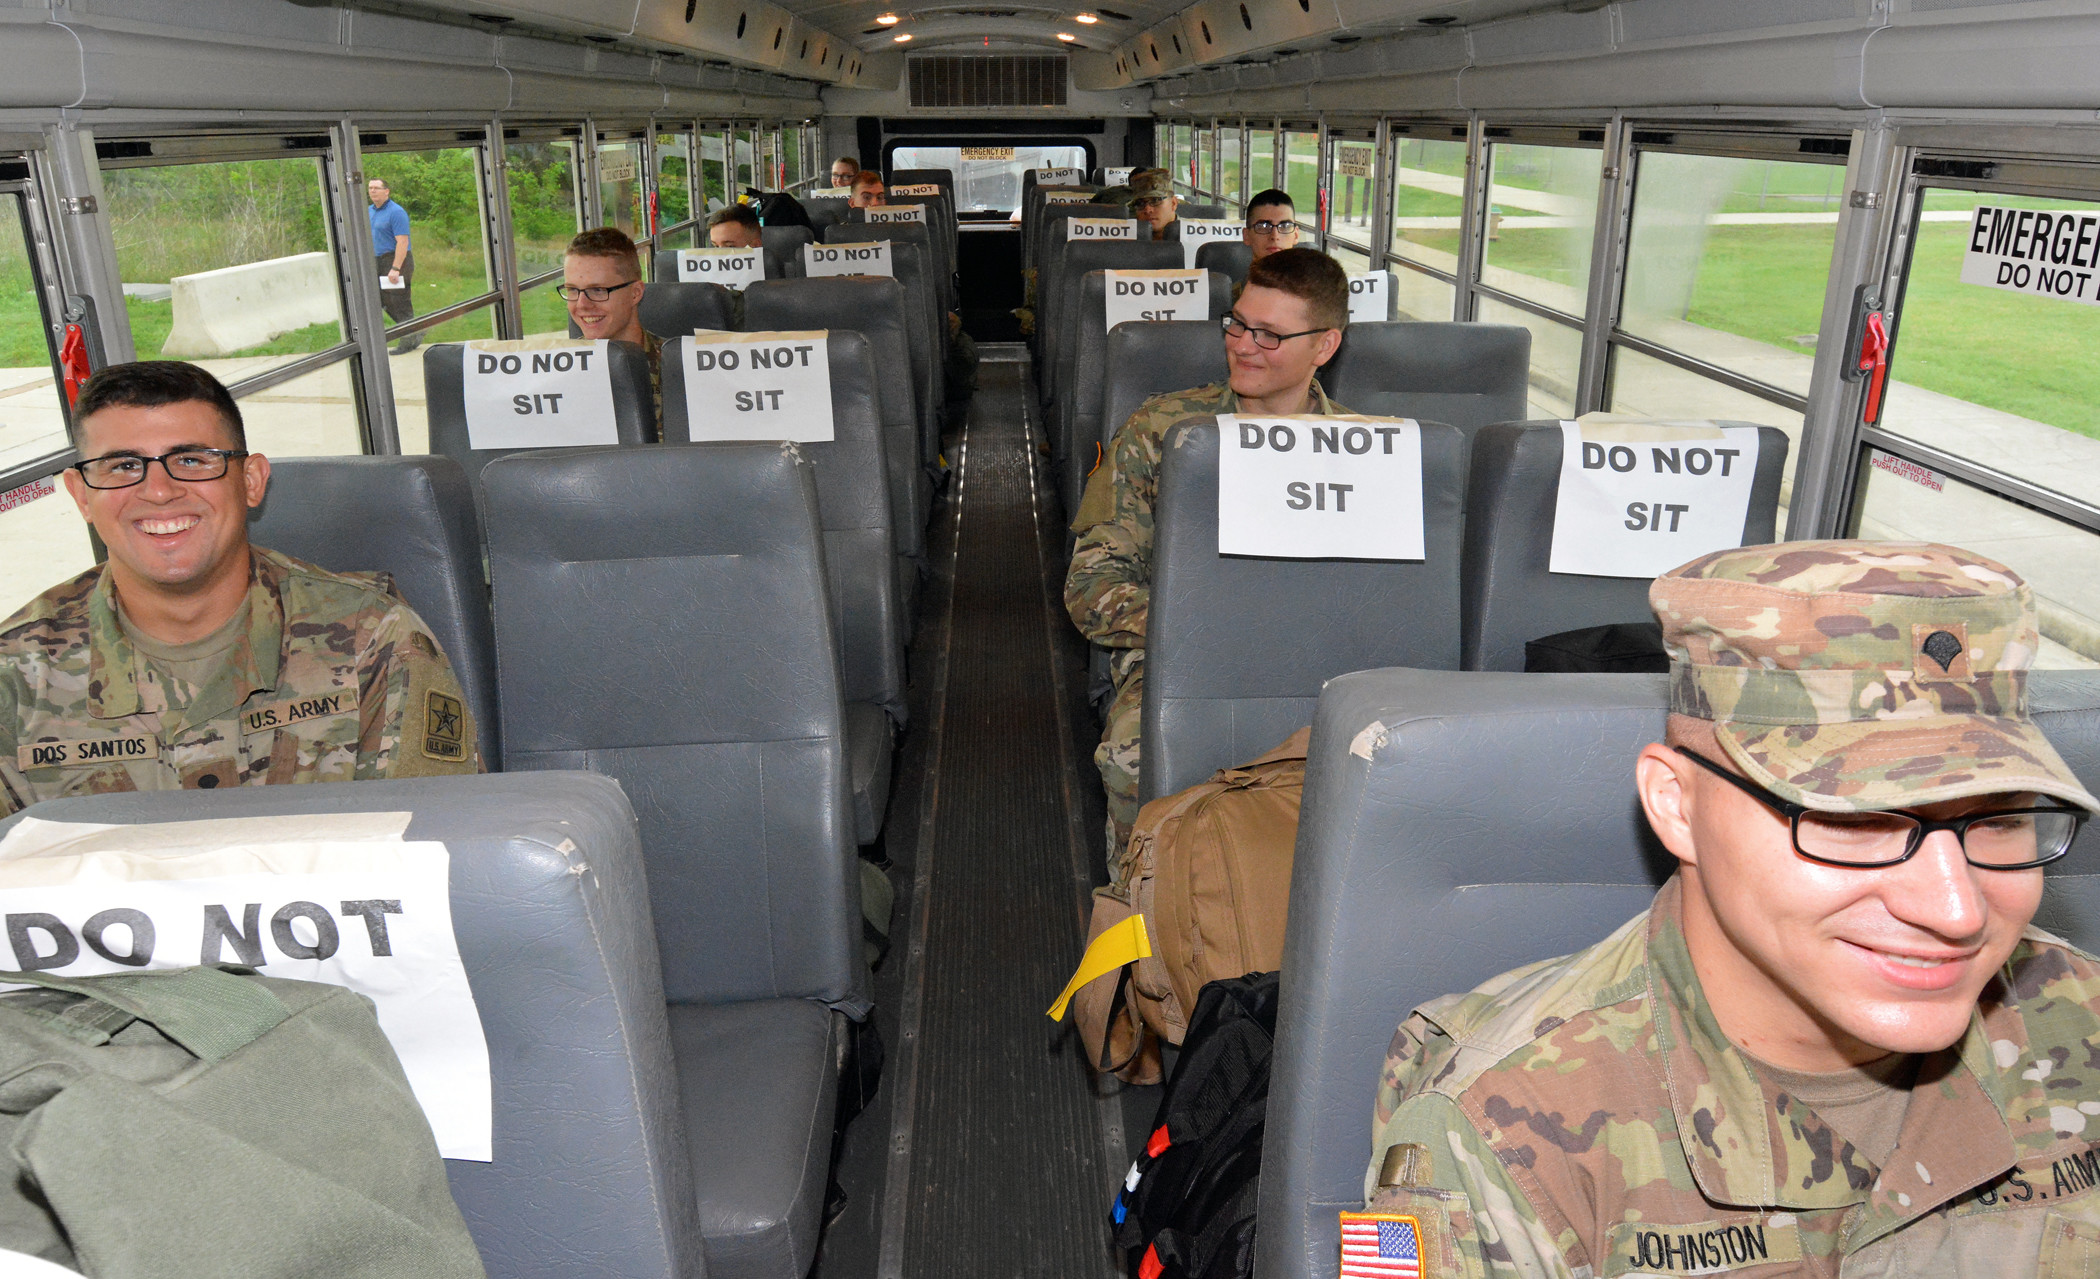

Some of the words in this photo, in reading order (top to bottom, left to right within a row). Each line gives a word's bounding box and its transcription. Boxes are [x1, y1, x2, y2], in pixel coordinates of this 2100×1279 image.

[961, 147, 998, 156] EMERGENCY
[1001, 147, 1014, 156] EXIT
[1040, 172, 1053, 180] DO
[1056, 169, 1074, 178] NOT
[913, 186, 933, 194] NOT
[871, 213, 889, 222] DO
[893, 210, 920, 221] NOT
[1074, 225, 1094, 236] DO
[1099, 226, 1130, 237] NOT
[1186, 225, 1207, 236] DO
[1212, 225, 1242, 237] NOT
[1971, 207, 2100, 269] EMERGE
[686, 259, 711, 272] DO
[718, 257, 755, 271] NOT
[813, 249, 838, 262] DO
[844, 247, 882, 261] NOT
[1115, 281, 1146, 296] DO
[1153, 279, 1199, 296] NOT
[1349, 278, 1378, 294] OT
[1997, 261, 2031, 288] DO
[2036, 267, 2092, 298] NOT
[1140, 309, 1176, 321] SIT
[478, 354, 522, 375] DO
[532, 350, 593, 374] NOT
[696, 350, 740, 372] DO
[750, 345, 813, 370] NOT
[513, 393, 563, 416] SIT
[735, 389, 784, 412] SIT
[1239, 423, 1296, 452] DO
[1312, 426, 1401, 455] NOT
[1582, 441, 1637, 473] DO
[1651, 447, 1740, 477] NOT
[1883, 454, 1900, 466] LIFT
[1900, 461, 1933, 480] HANDLE
[1872, 458, 1891, 472] PUSH
[1892, 466, 1908, 478] OUT
[1909, 472, 1920, 482] TO
[1920, 477, 1943, 492] OPEN
[0, 499, 16, 512] OUT
[18, 494, 31, 504] TO
[32, 485, 55, 500] OPEN
[5, 481, 41, 501] HANDLE
[1286, 481, 1353, 512] SIT
[1624, 501, 1689, 532] SIT
[250, 709, 282, 730] U.S.
[288, 695, 339, 721] ARMY
[32, 744, 67, 765] DOS
[78, 738, 146, 759] SANTOS
[5, 908, 156, 972] DO
[200, 899, 404, 967] NOT
[2052, 1148, 2100, 1197] ARM
[1629, 1224, 1769, 1270] JOHNSTON
